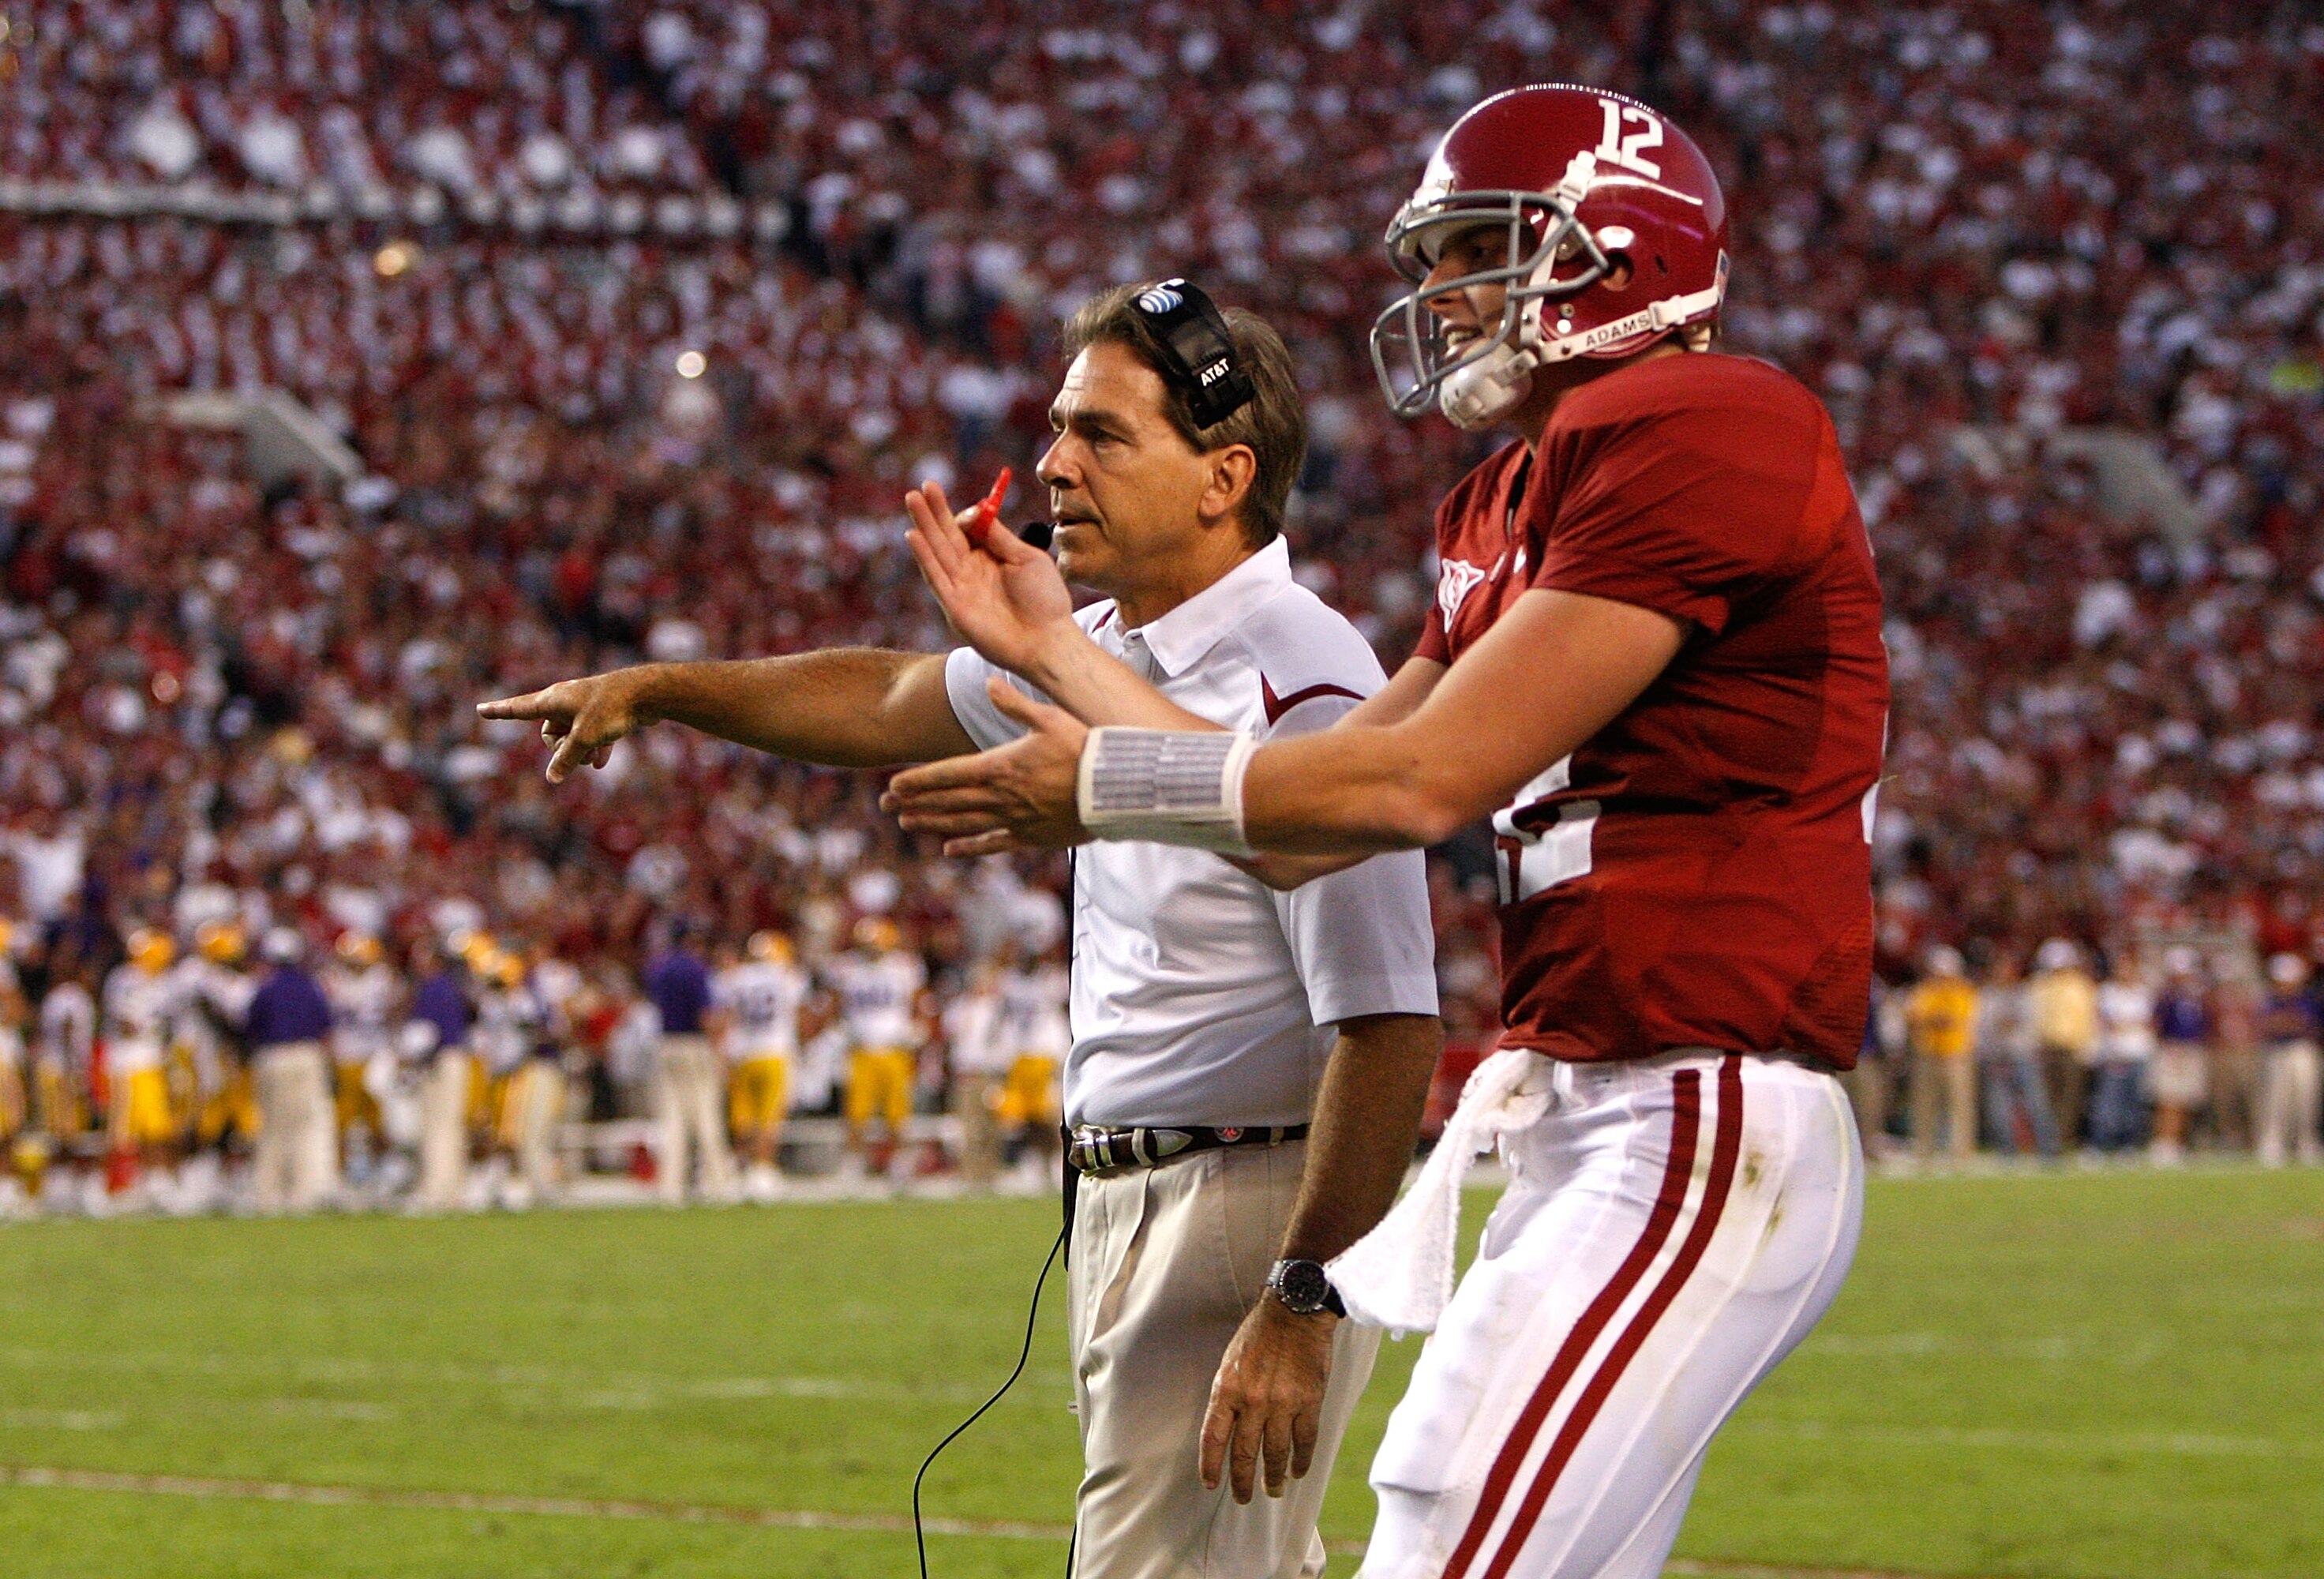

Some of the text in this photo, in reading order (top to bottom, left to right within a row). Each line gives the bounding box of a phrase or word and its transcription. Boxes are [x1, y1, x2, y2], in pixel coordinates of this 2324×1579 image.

[1595, 98, 1663, 181] 12
[1586, 314, 1651, 347] ADAMS
[1199, 358, 1230, 387] AT&T
